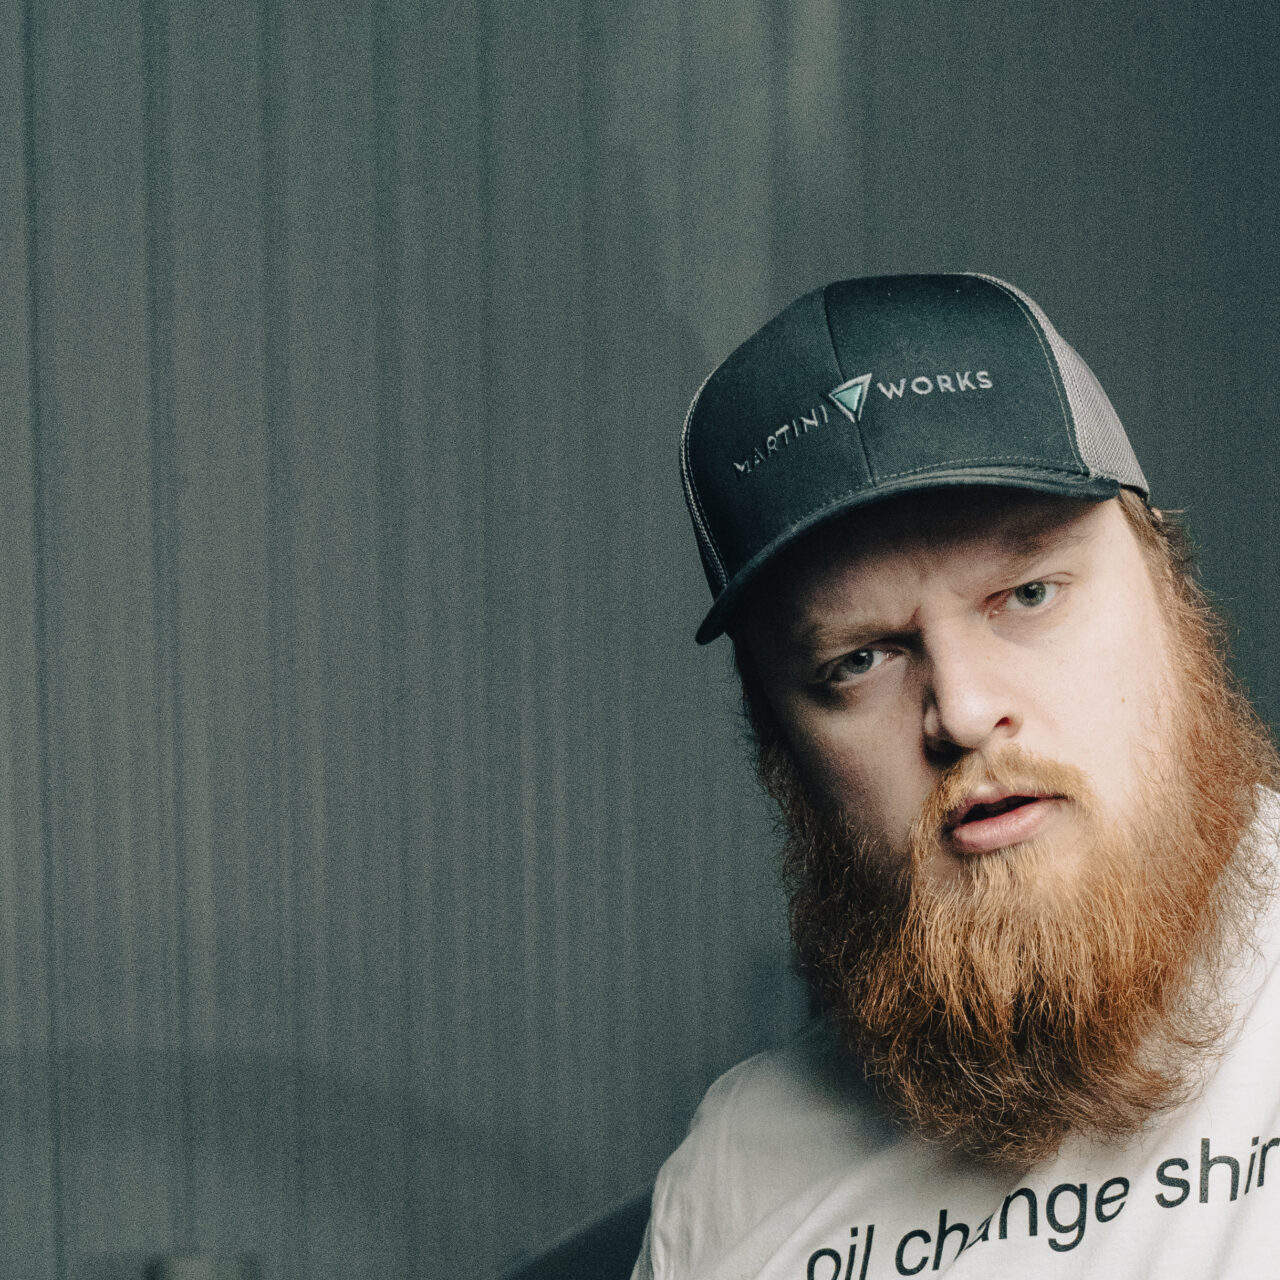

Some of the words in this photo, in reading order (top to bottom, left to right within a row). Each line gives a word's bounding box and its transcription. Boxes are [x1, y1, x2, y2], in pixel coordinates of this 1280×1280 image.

[733, 403, 829, 478] MARTINI
[876, 370, 993, 400] WORKS
[894, 1176, 1131, 1277] change
